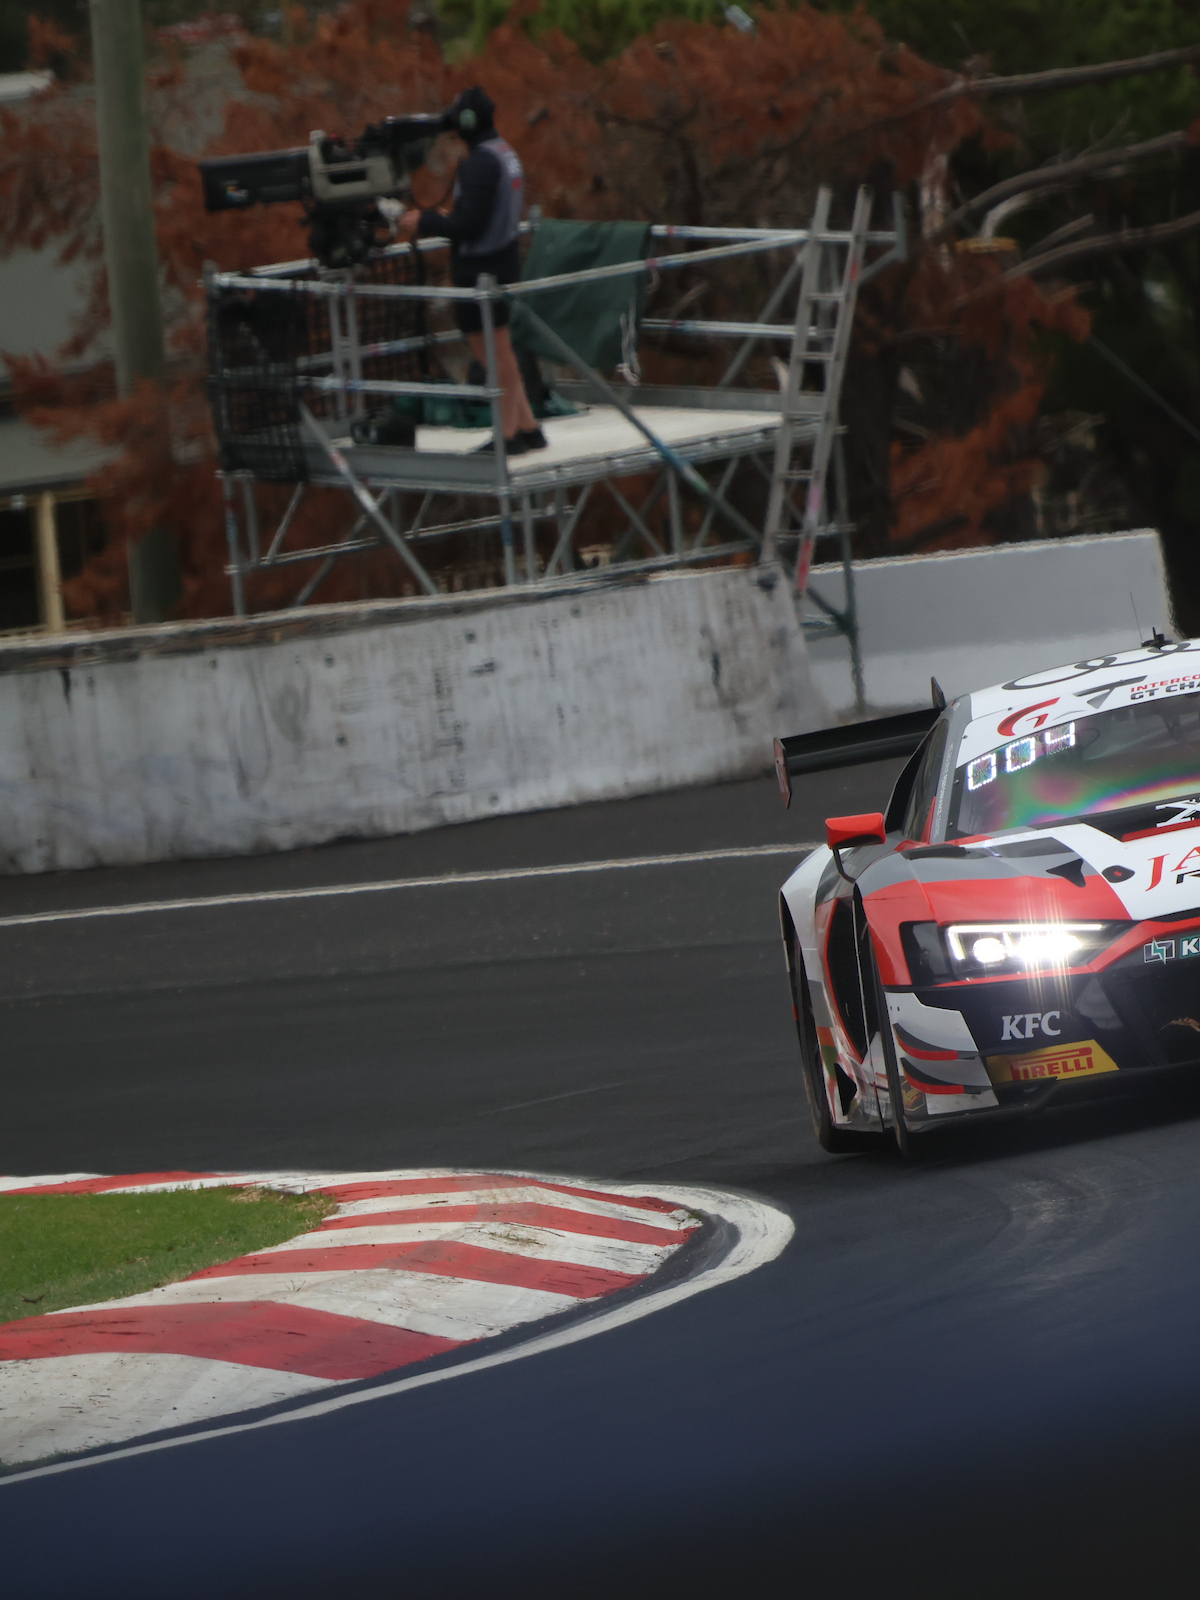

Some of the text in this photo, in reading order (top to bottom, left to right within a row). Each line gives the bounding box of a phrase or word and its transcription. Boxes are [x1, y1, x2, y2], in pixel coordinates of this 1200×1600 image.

[1130, 687, 1160, 701] GT
[967, 721, 1076, 791] 004
[1000, 1010, 1061, 1041] KFC
[1010, 1046, 1094, 1081] PIRELLI
